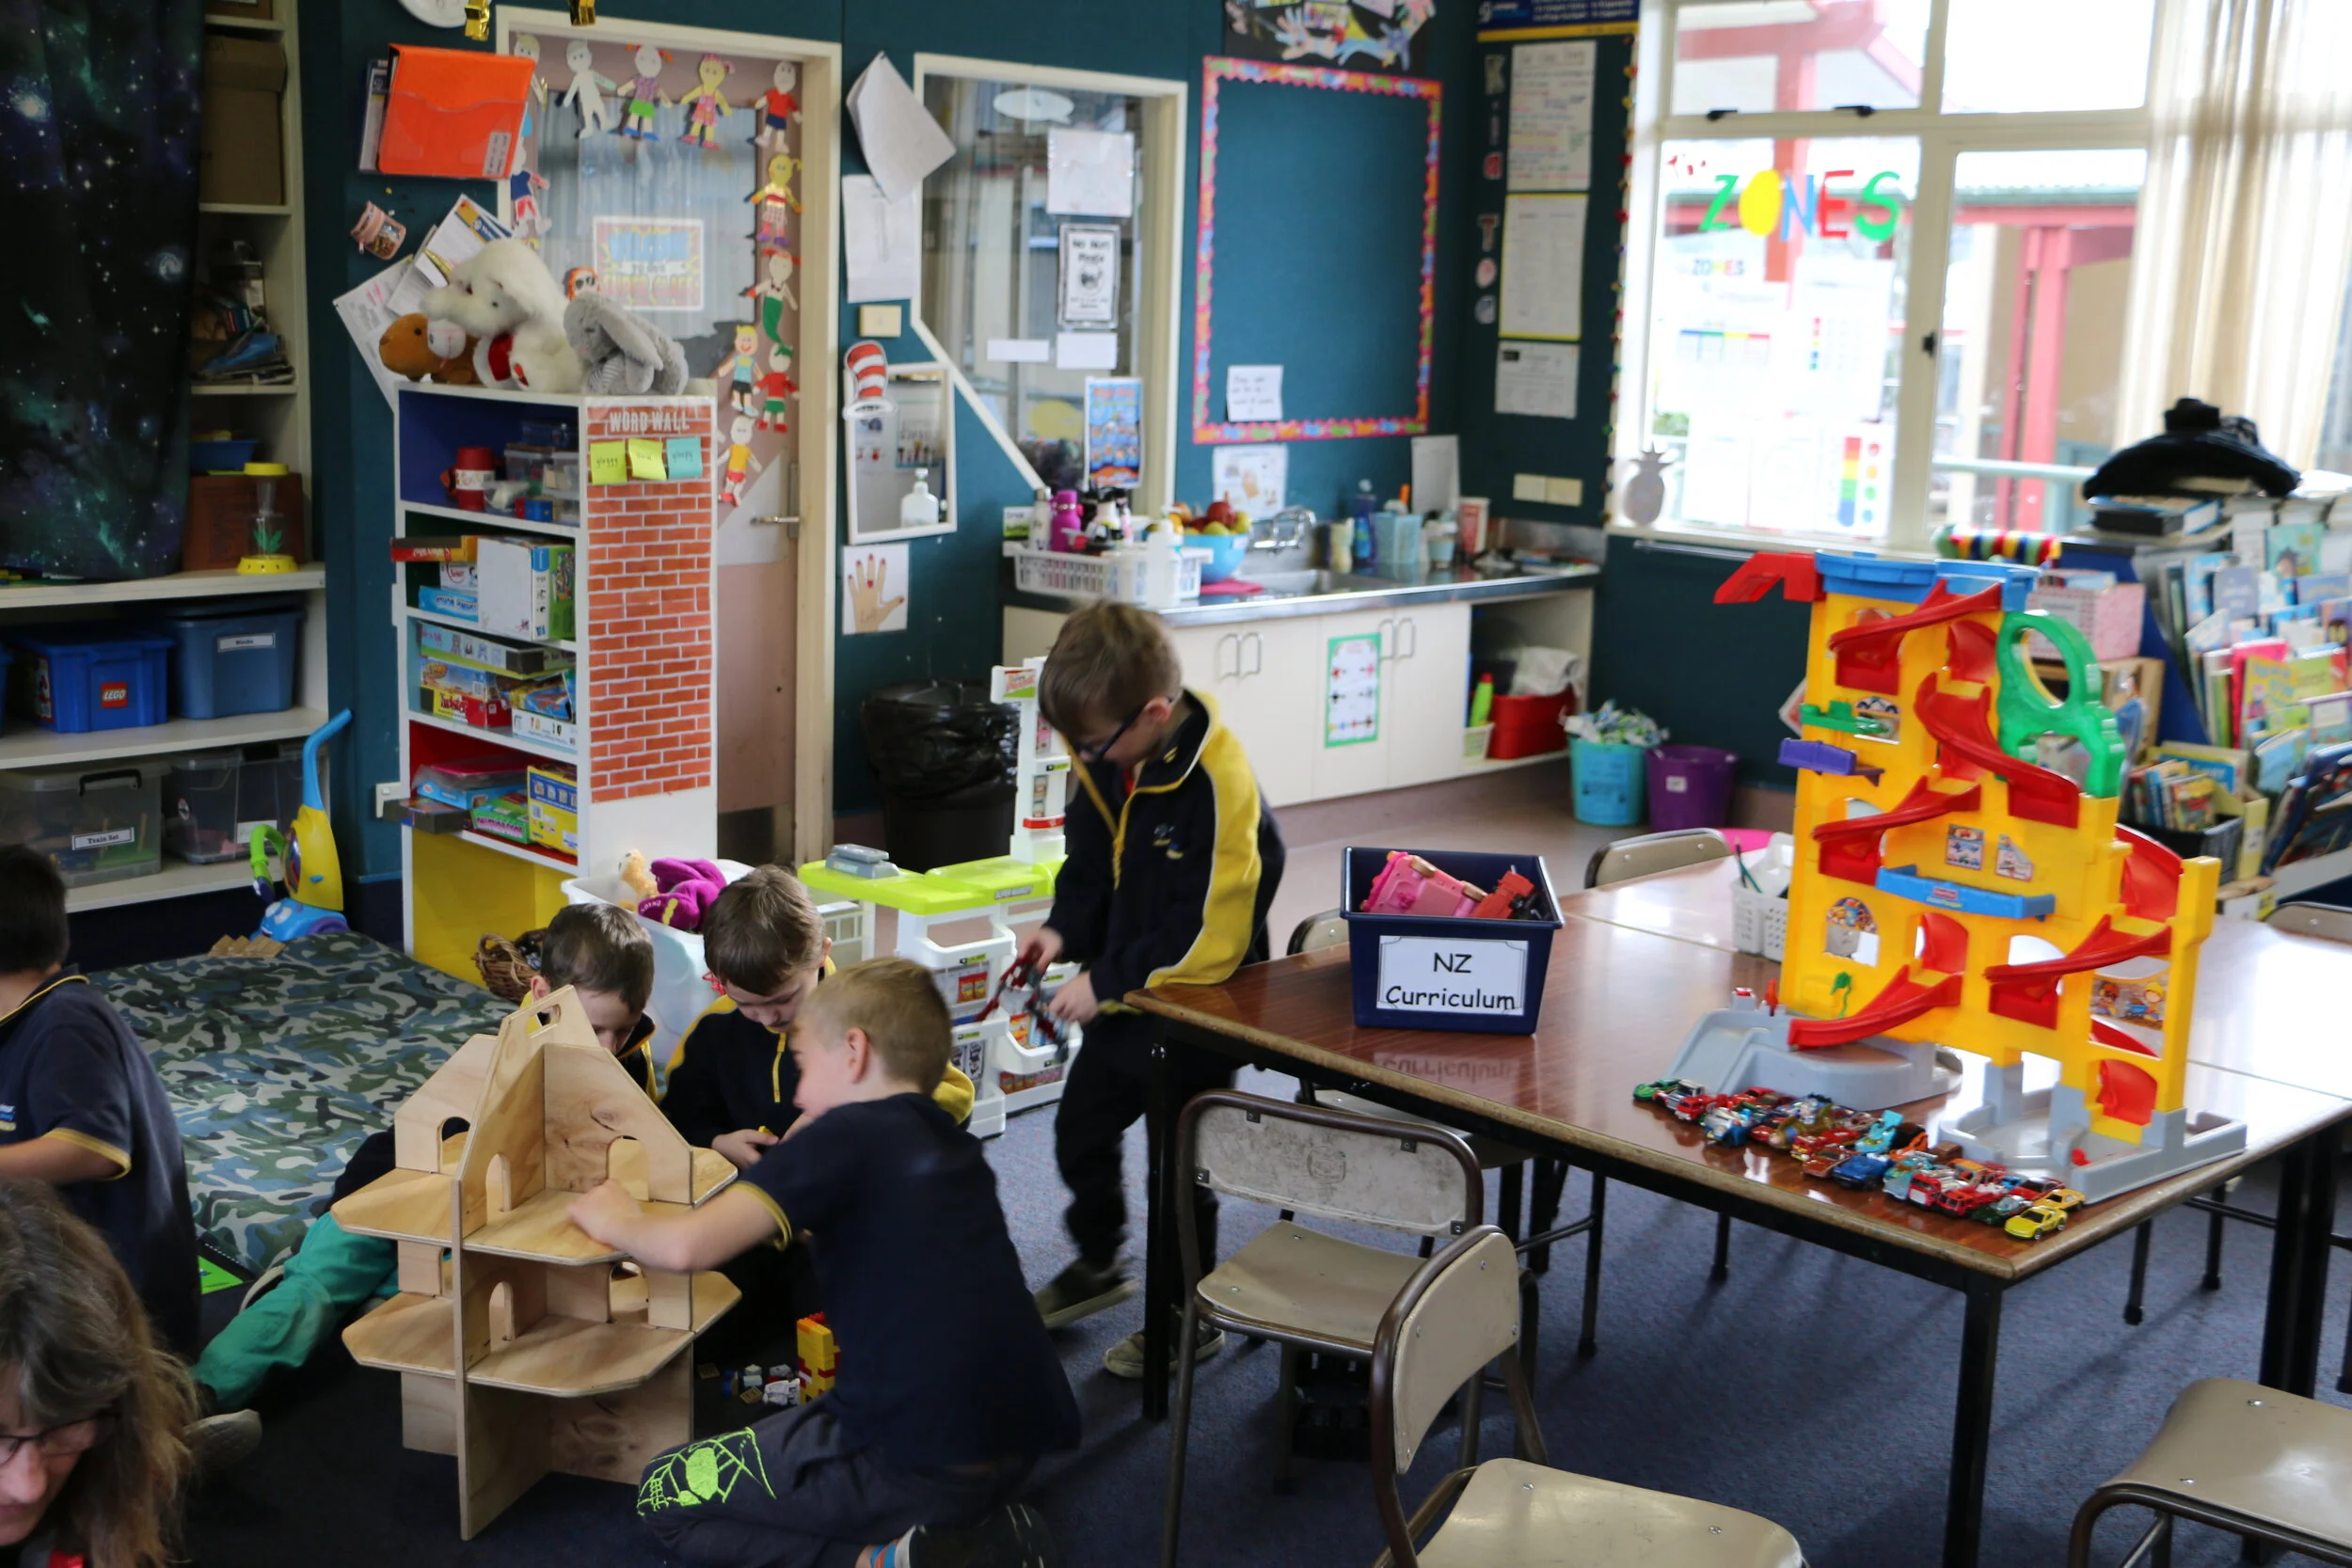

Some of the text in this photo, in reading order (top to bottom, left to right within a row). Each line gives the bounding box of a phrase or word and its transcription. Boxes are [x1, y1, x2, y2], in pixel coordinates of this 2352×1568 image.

[1699, 170, 1900, 242] ZONES
[610, 408, 691, 433] WORD WALL
[103, 689, 125, 701] LEGO
[87, 836, 108, 845] Train
[1433, 951, 1473, 974] NZ
[1386, 985, 1516, 1010] Curriculum
